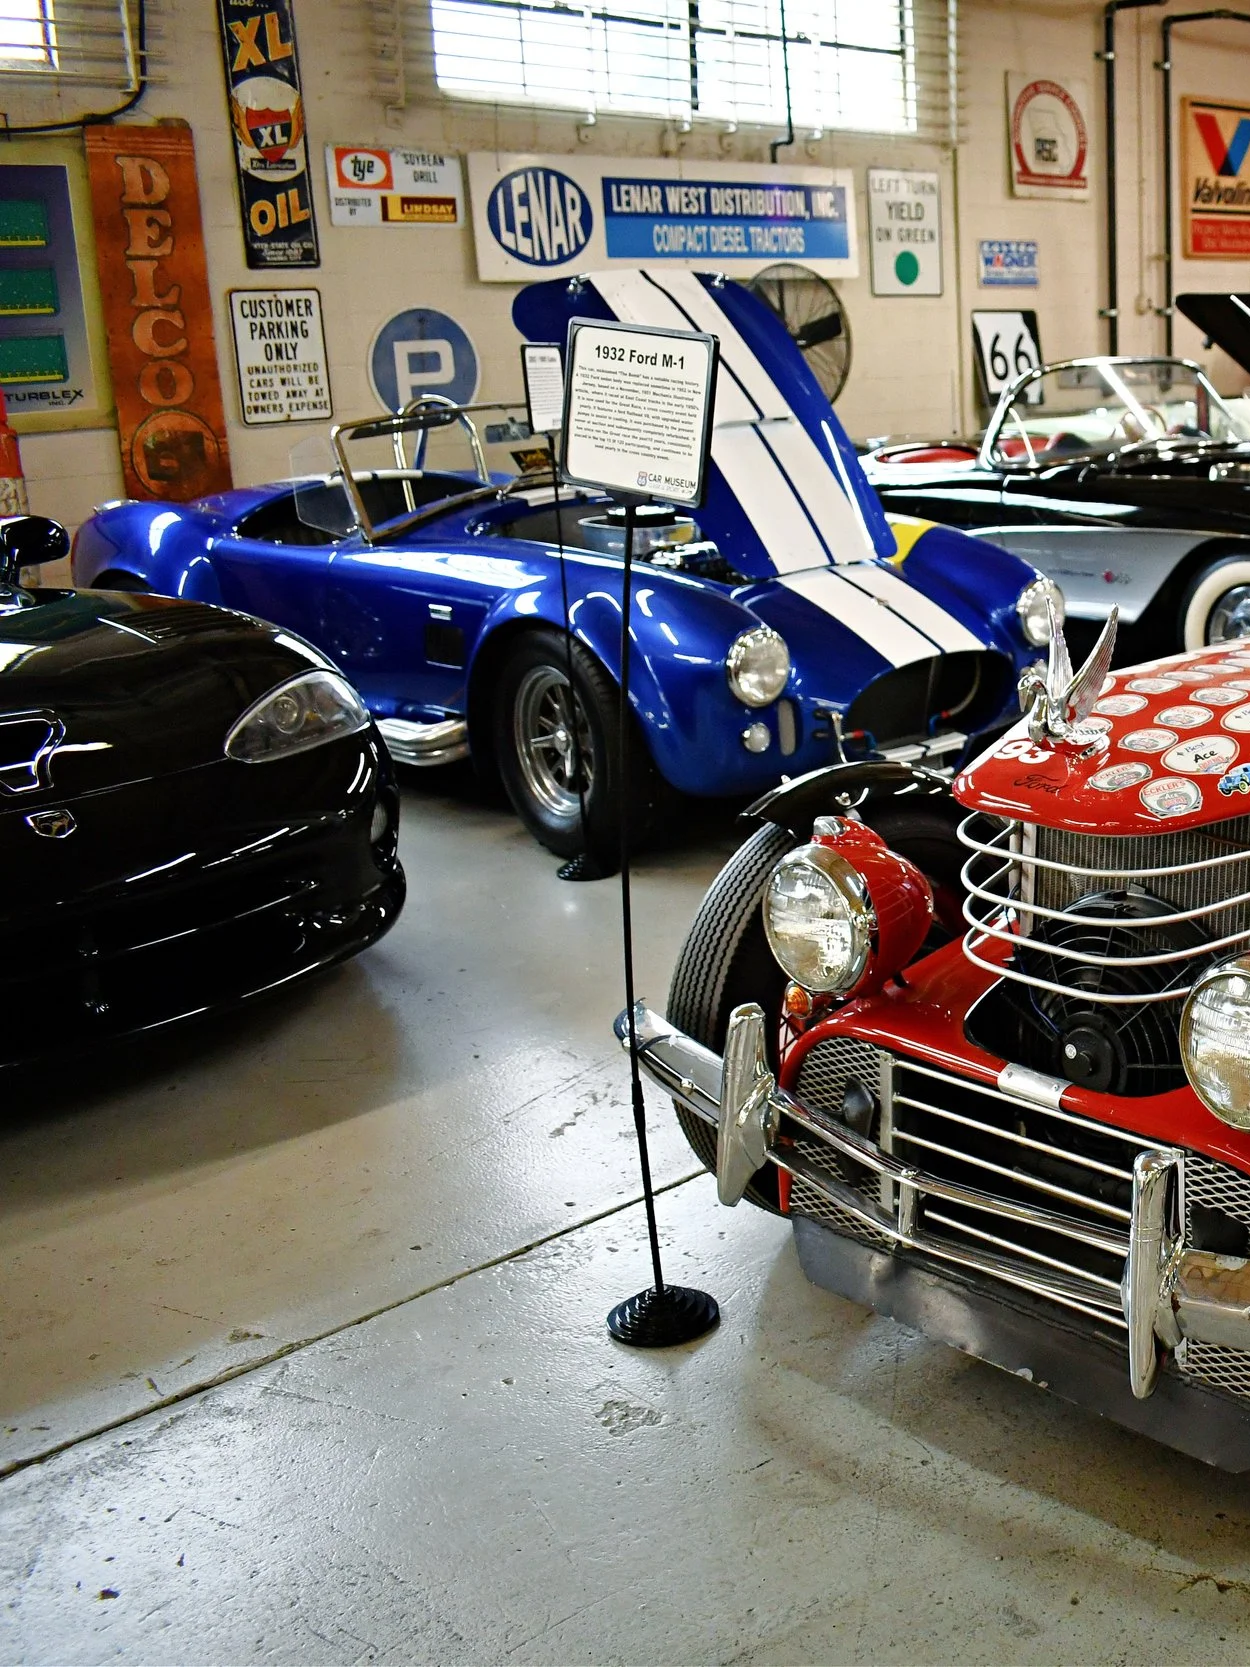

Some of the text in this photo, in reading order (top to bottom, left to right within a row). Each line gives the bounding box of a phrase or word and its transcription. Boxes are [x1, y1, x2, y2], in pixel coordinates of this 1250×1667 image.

[228, 12, 293, 72] XL
[259, 124, 288, 147] XL
[351, 155, 375, 182] tye
[403, 153, 445, 167] SOYBEAN
[413, 170, 438, 183] DRILL
[872, 177, 937, 195] LEFT TURN
[334, 197, 372, 207] DISTRIBUTED
[349, 207, 357, 216] BY
[403, 204, 453, 214] LINDSAY
[611, 184, 839, 220] LENAR WEST DISTRIBUTION, INC.
[885, 200, 925, 221] YIELD
[250, 188, 311, 237] OIL
[497, 168, 587, 260] LENAR
[652, 224, 805, 253] COMPACT DIESEL TRACTORS
[876, 226, 936, 243] ON GREEN
[115, 155, 195, 406] DELCO
[240, 298, 313, 319] CUSTOMER
[250, 321, 309, 341] PARKING
[264, 342, 298, 362] ONLY
[595, 345, 684, 370] 1932 Ford M-1
[990, 333, 1032, 380] 66
[247, 362, 319, 375] UNAUTHORIZED
[393, 339, 455, 404] P
[250, 374, 320, 388] CARS WILL BE
[4, 389, 84, 405] TURBLEX
[248, 387, 324, 402] TOWED AWAY AT
[246, 400, 329, 416] OWNERS EXPENSE
[648, 473, 696, 489] CAR MUSEUM
[993, 740, 1055, 764] 93
[1185, 742, 1205, 753] Best
[1193, 750, 1218, 763] Ace
[1014, 774, 1067, 794] Ford
[1143, 780, 1186, 796] ECKLER'S
